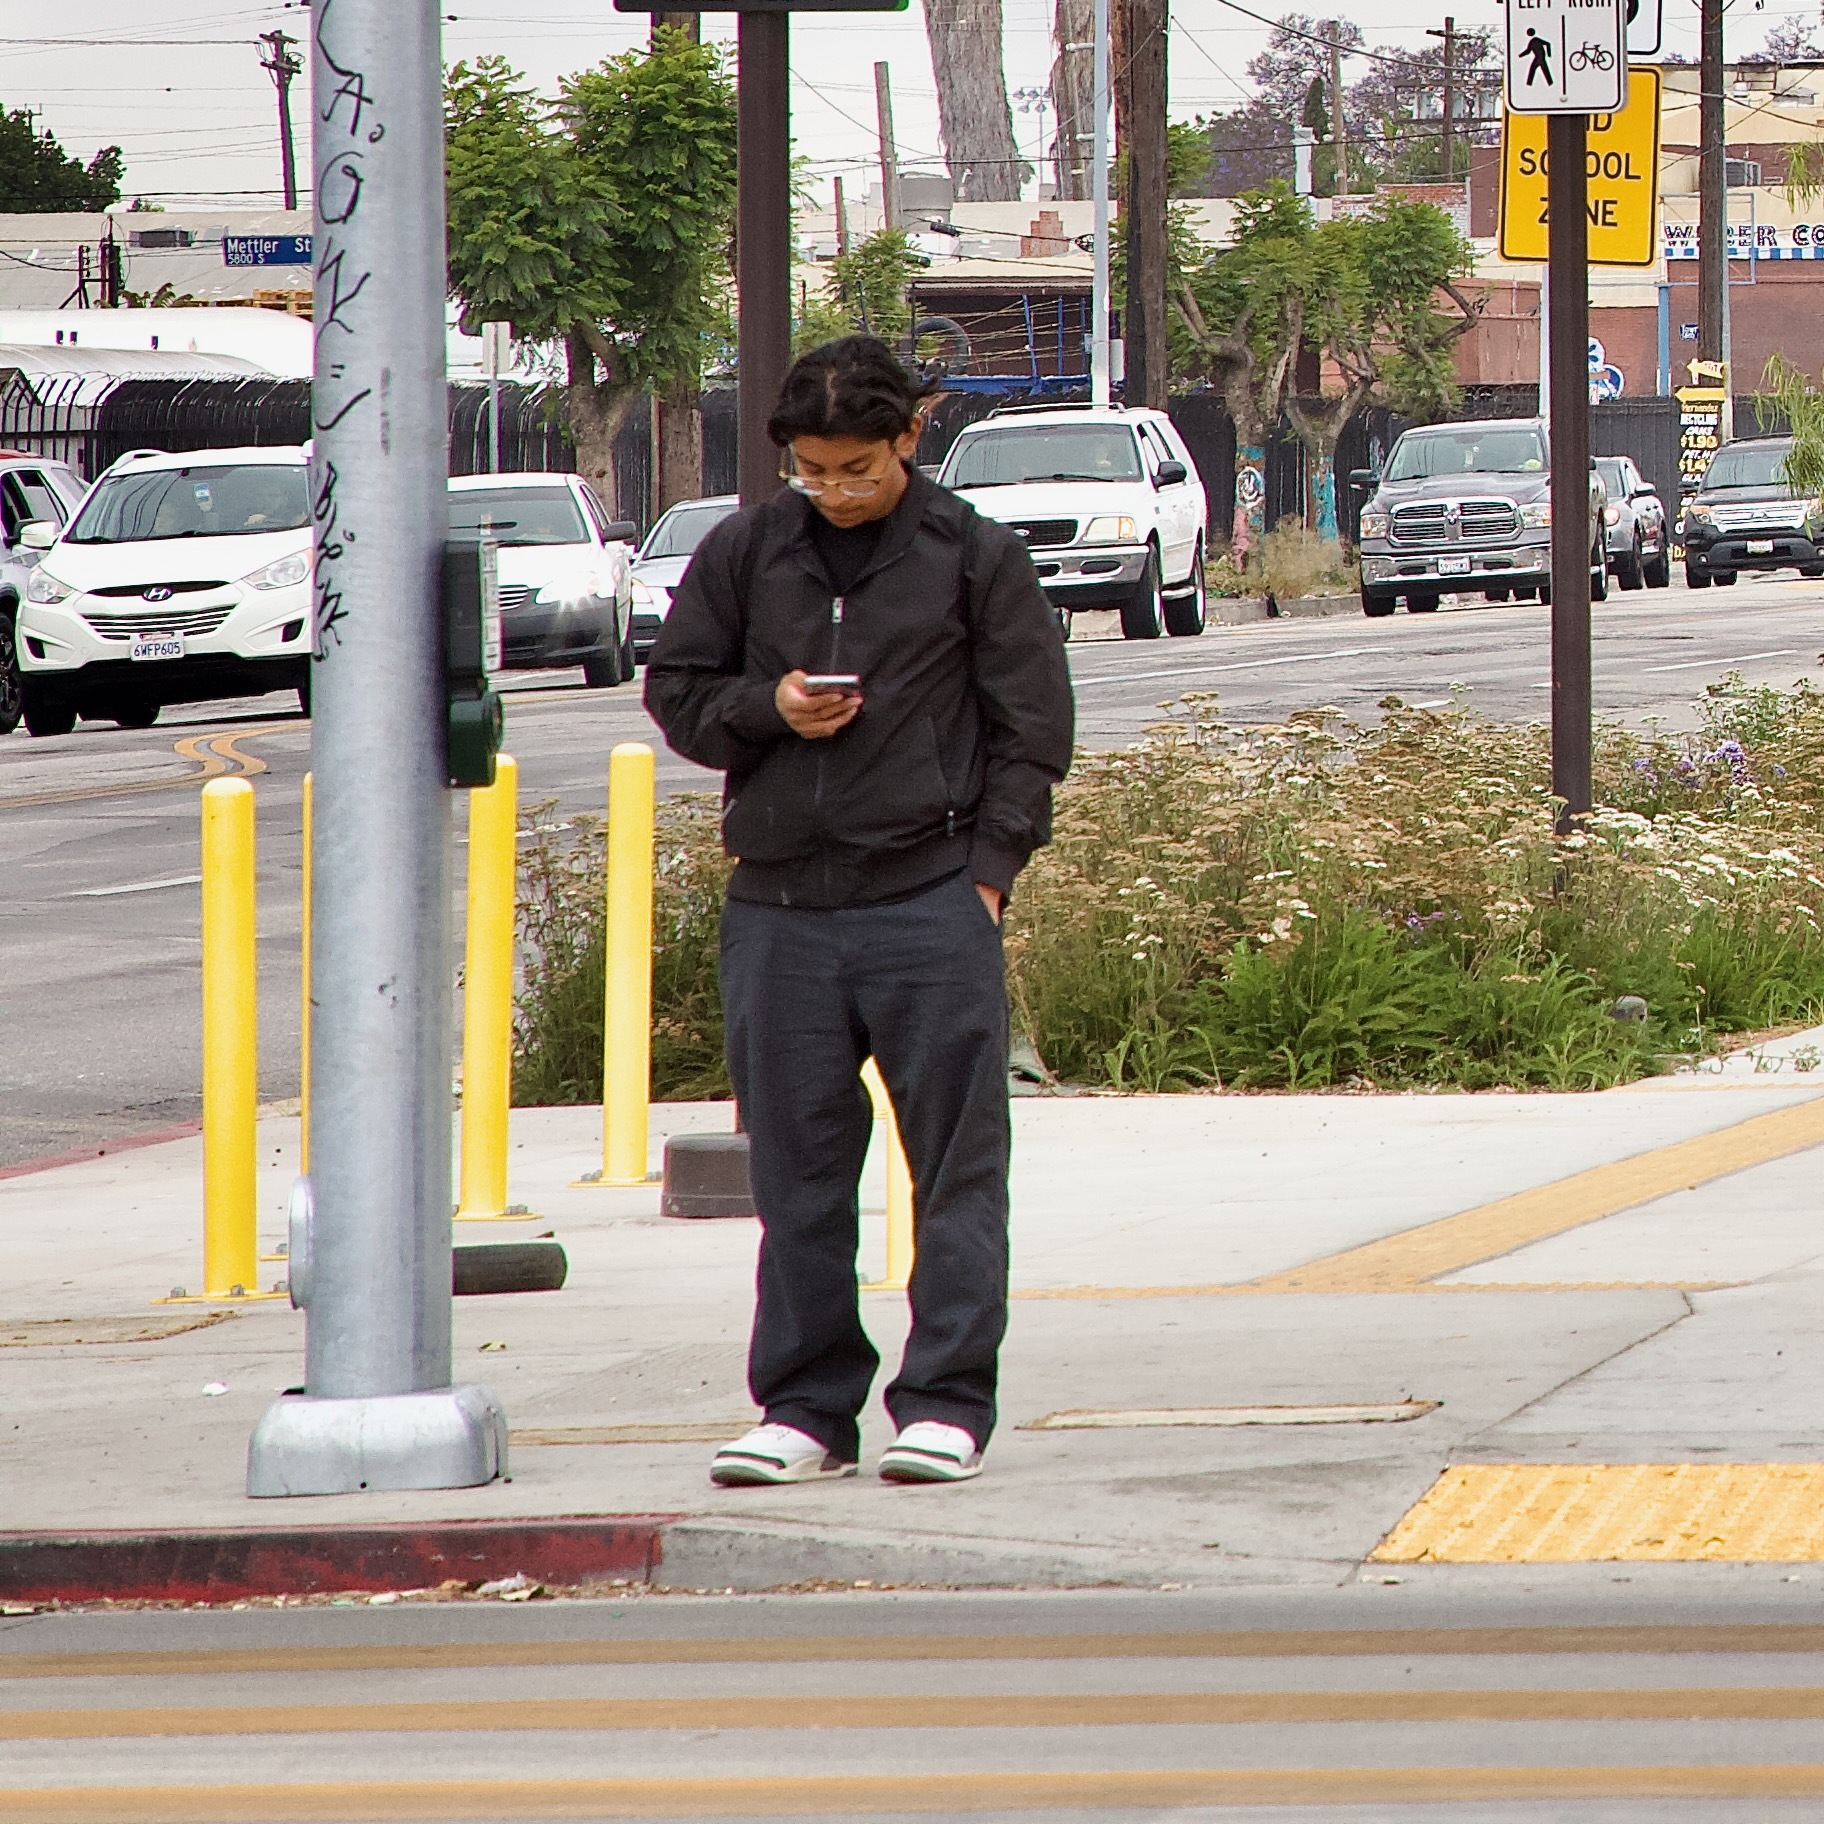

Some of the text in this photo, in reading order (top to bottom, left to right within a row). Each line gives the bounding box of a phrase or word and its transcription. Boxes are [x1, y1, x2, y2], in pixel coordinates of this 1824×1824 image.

[227, 237, 311, 253] Mettler St
[227, 253, 264, 264] 5800 S
[1680, 435, 1718, 448] $1.90
[134, 642, 180, 656] 6WFP605
